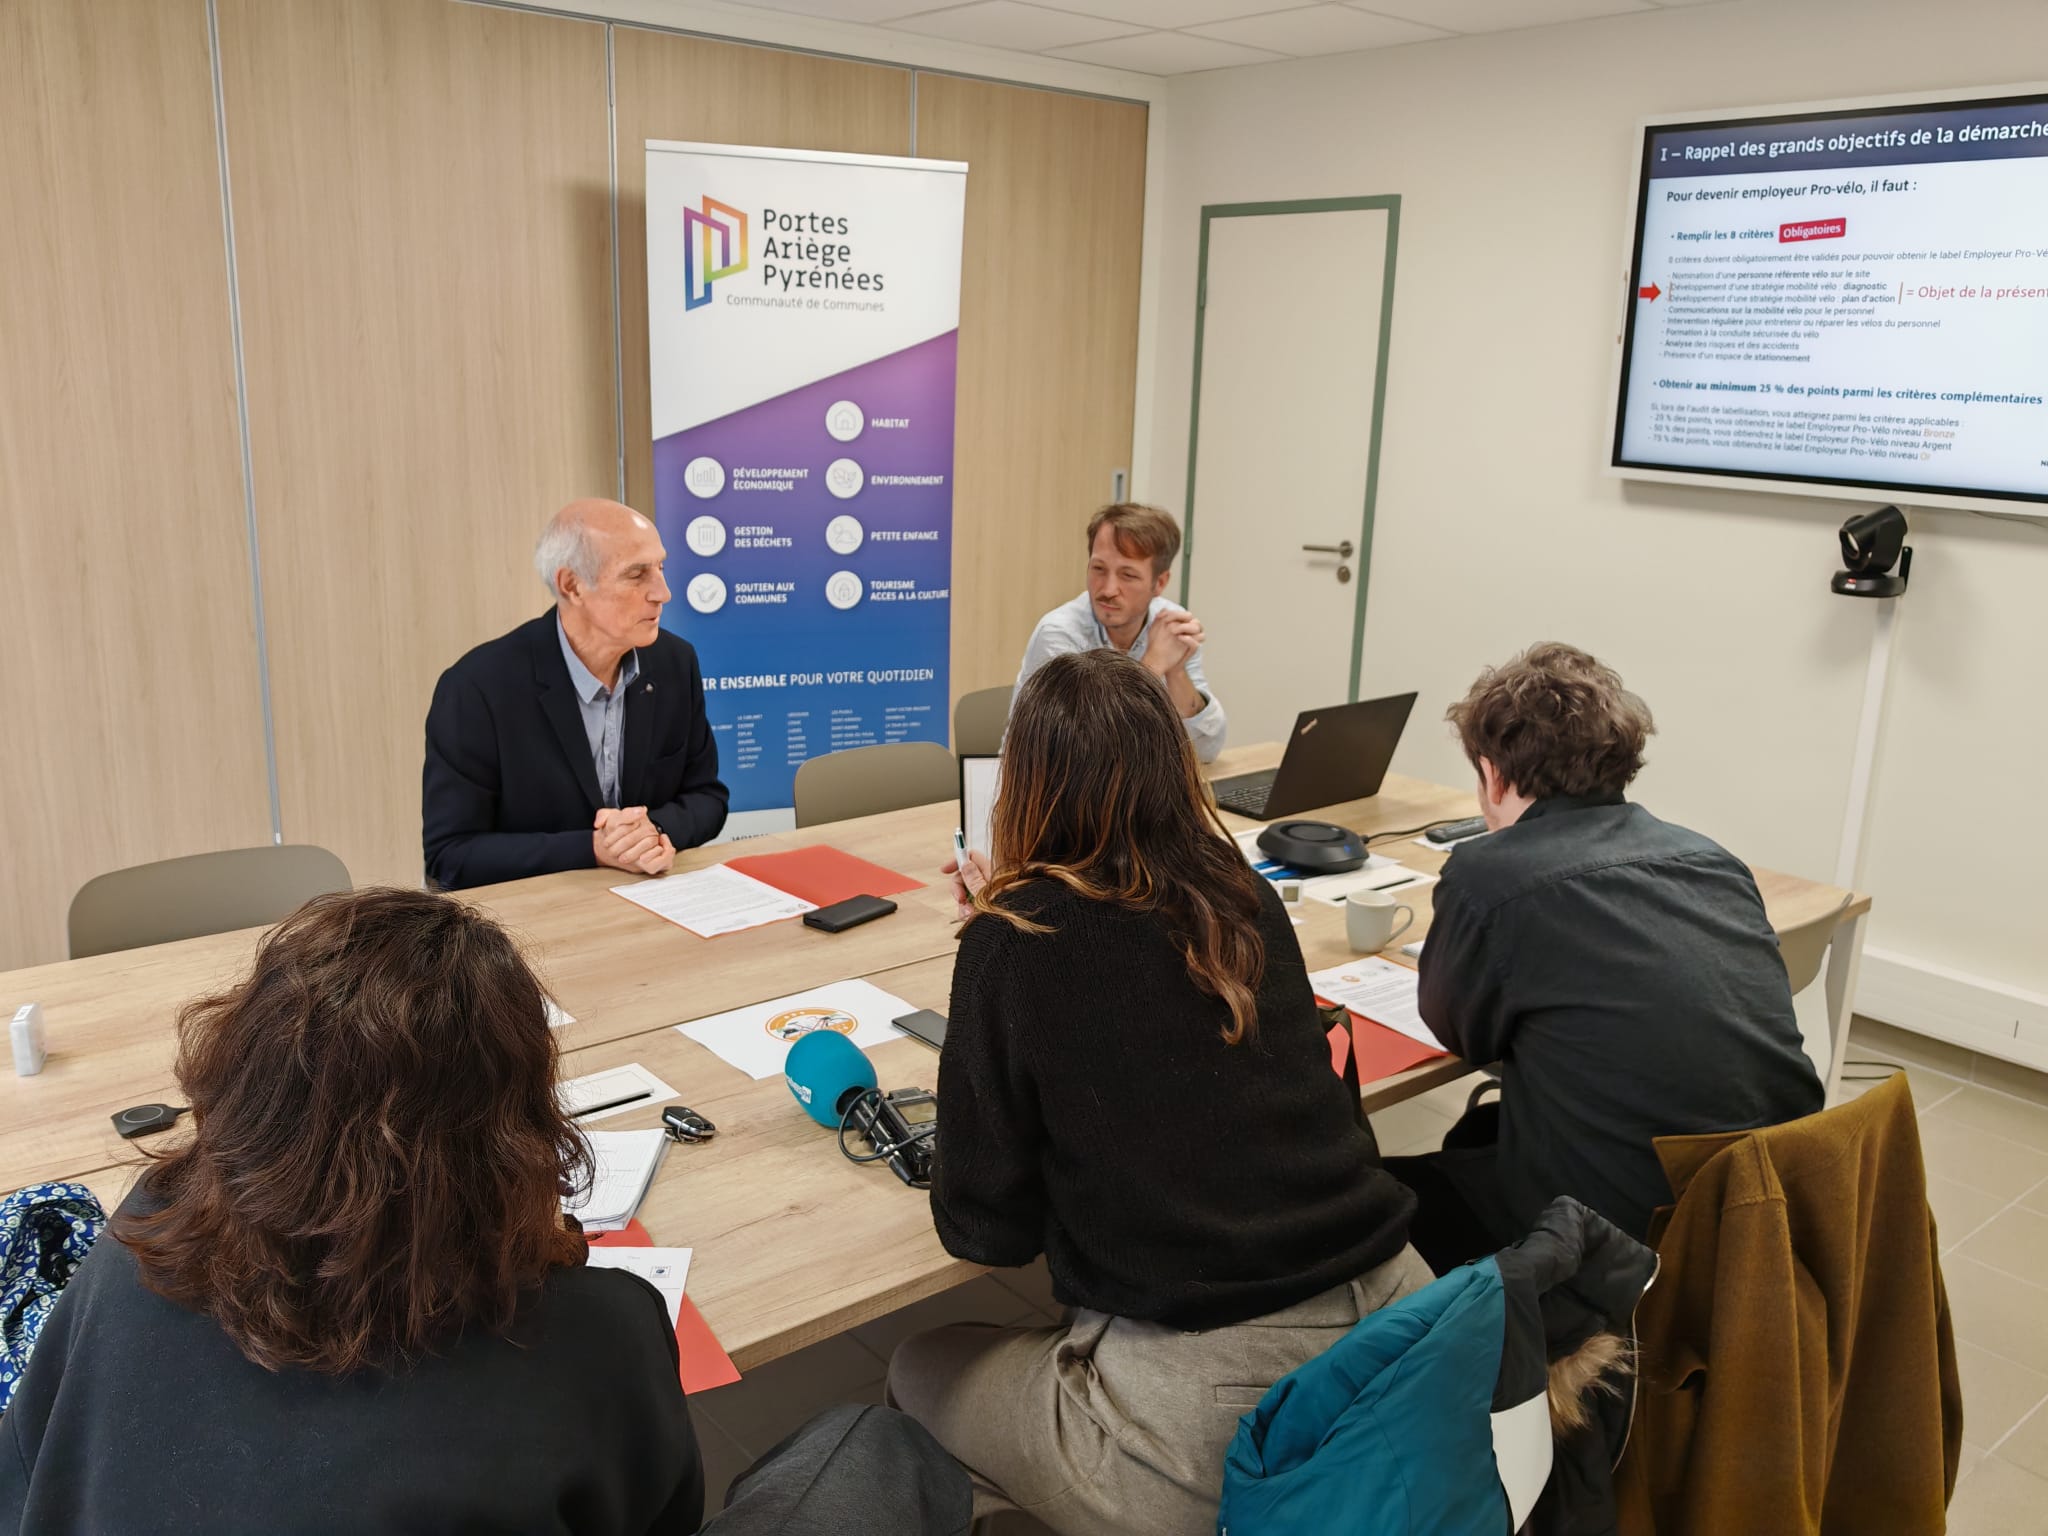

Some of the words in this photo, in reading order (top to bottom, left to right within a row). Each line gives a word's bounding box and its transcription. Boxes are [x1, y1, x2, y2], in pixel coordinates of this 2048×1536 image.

[1685, 142, 1735, 161] Rappel
[1739, 141, 1766, 157] des
[1769, 137, 1824, 157] grands
[1828, 131, 1906, 152] objectifs
[1910, 129, 1931, 145] de
[1936, 127, 1953, 143] la
[1667, 191, 1692, 202] Pour
[1695, 188, 1739, 201] devenir
[1742, 184, 1807, 201] employeur
[1810, 182, 1866, 196] Pro-vélo,
[1870, 181, 1878, 193] il
[1881, 180, 1909, 192] faut
[764, 209, 848, 235] Portes
[1677, 231, 1711, 243] Remplir
[1714, 230, 1727, 240] les
[1739, 228, 1774, 240] critères
[1783, 224, 1841, 239] Obligatoires
[764, 237, 851, 267] Ariège
[1703, 255, 1730, 263] doivent
[1733, 254, 1791, 264] obligatoirement
[1794, 254, 1809, 262] être
[1811, 253, 1839, 261] validés
[1862, 253, 1894, 261] pouvoir
[1964, 250, 2012, 260] Employeur
[764, 265, 884, 292] Pyrénées
[1918, 286, 1954, 300] Objet
[1960, 286, 1976, 297] de
[1981, 286, 1991, 297] la
[727, 294, 803, 308] Communauté
[807, 299, 819, 309] de
[824, 299, 884, 312] Communes
[1659, 379, 1693, 389] Obtenir
[1696, 382, 1707, 390] au
[1711, 382, 1756, 392] minimum
[1760, 384, 1770, 392] 25
[1775, 385, 1784, 393] %
[1787, 385, 1804, 394] des
[1808, 386, 1839, 397] points
[1843, 387, 1873, 400] parmi
[1877, 387, 1892, 399] les
[1896, 388, 1936, 401] critères
[1941, 390, 2042, 405] complémentaires
[872, 419, 909, 428] HABITAT
[1922, 441, 1952, 451] Argent
[733, 467, 808, 479] DÉVELOPPEMENT
[734, 478, 794, 491] ÉCONOMIQUE
[871, 475, 943, 485] ENVIRONNEMENT
[735, 526, 773, 536] GESTION
[871, 531, 900, 541] PETITE
[903, 531, 938, 540] ENFANCE
[735, 538, 751, 547] DES
[753, 536, 792, 547] DÉCHETS
[736, 583, 775, 592] SOUTIEN
[778, 583, 795, 591] AUX
[871, 580, 915, 590] TOURISME
[736, 594, 787, 604] COMMUNES
[906, 591, 916, 600] LA
[918, 589, 949, 599] CULTURE
[720, 675, 787, 690] ENSEMBLE
[790, 673, 823, 686] POUR
[827, 671, 864, 684] VOTRE
[868, 668, 933, 684] QUOTIDIEN
